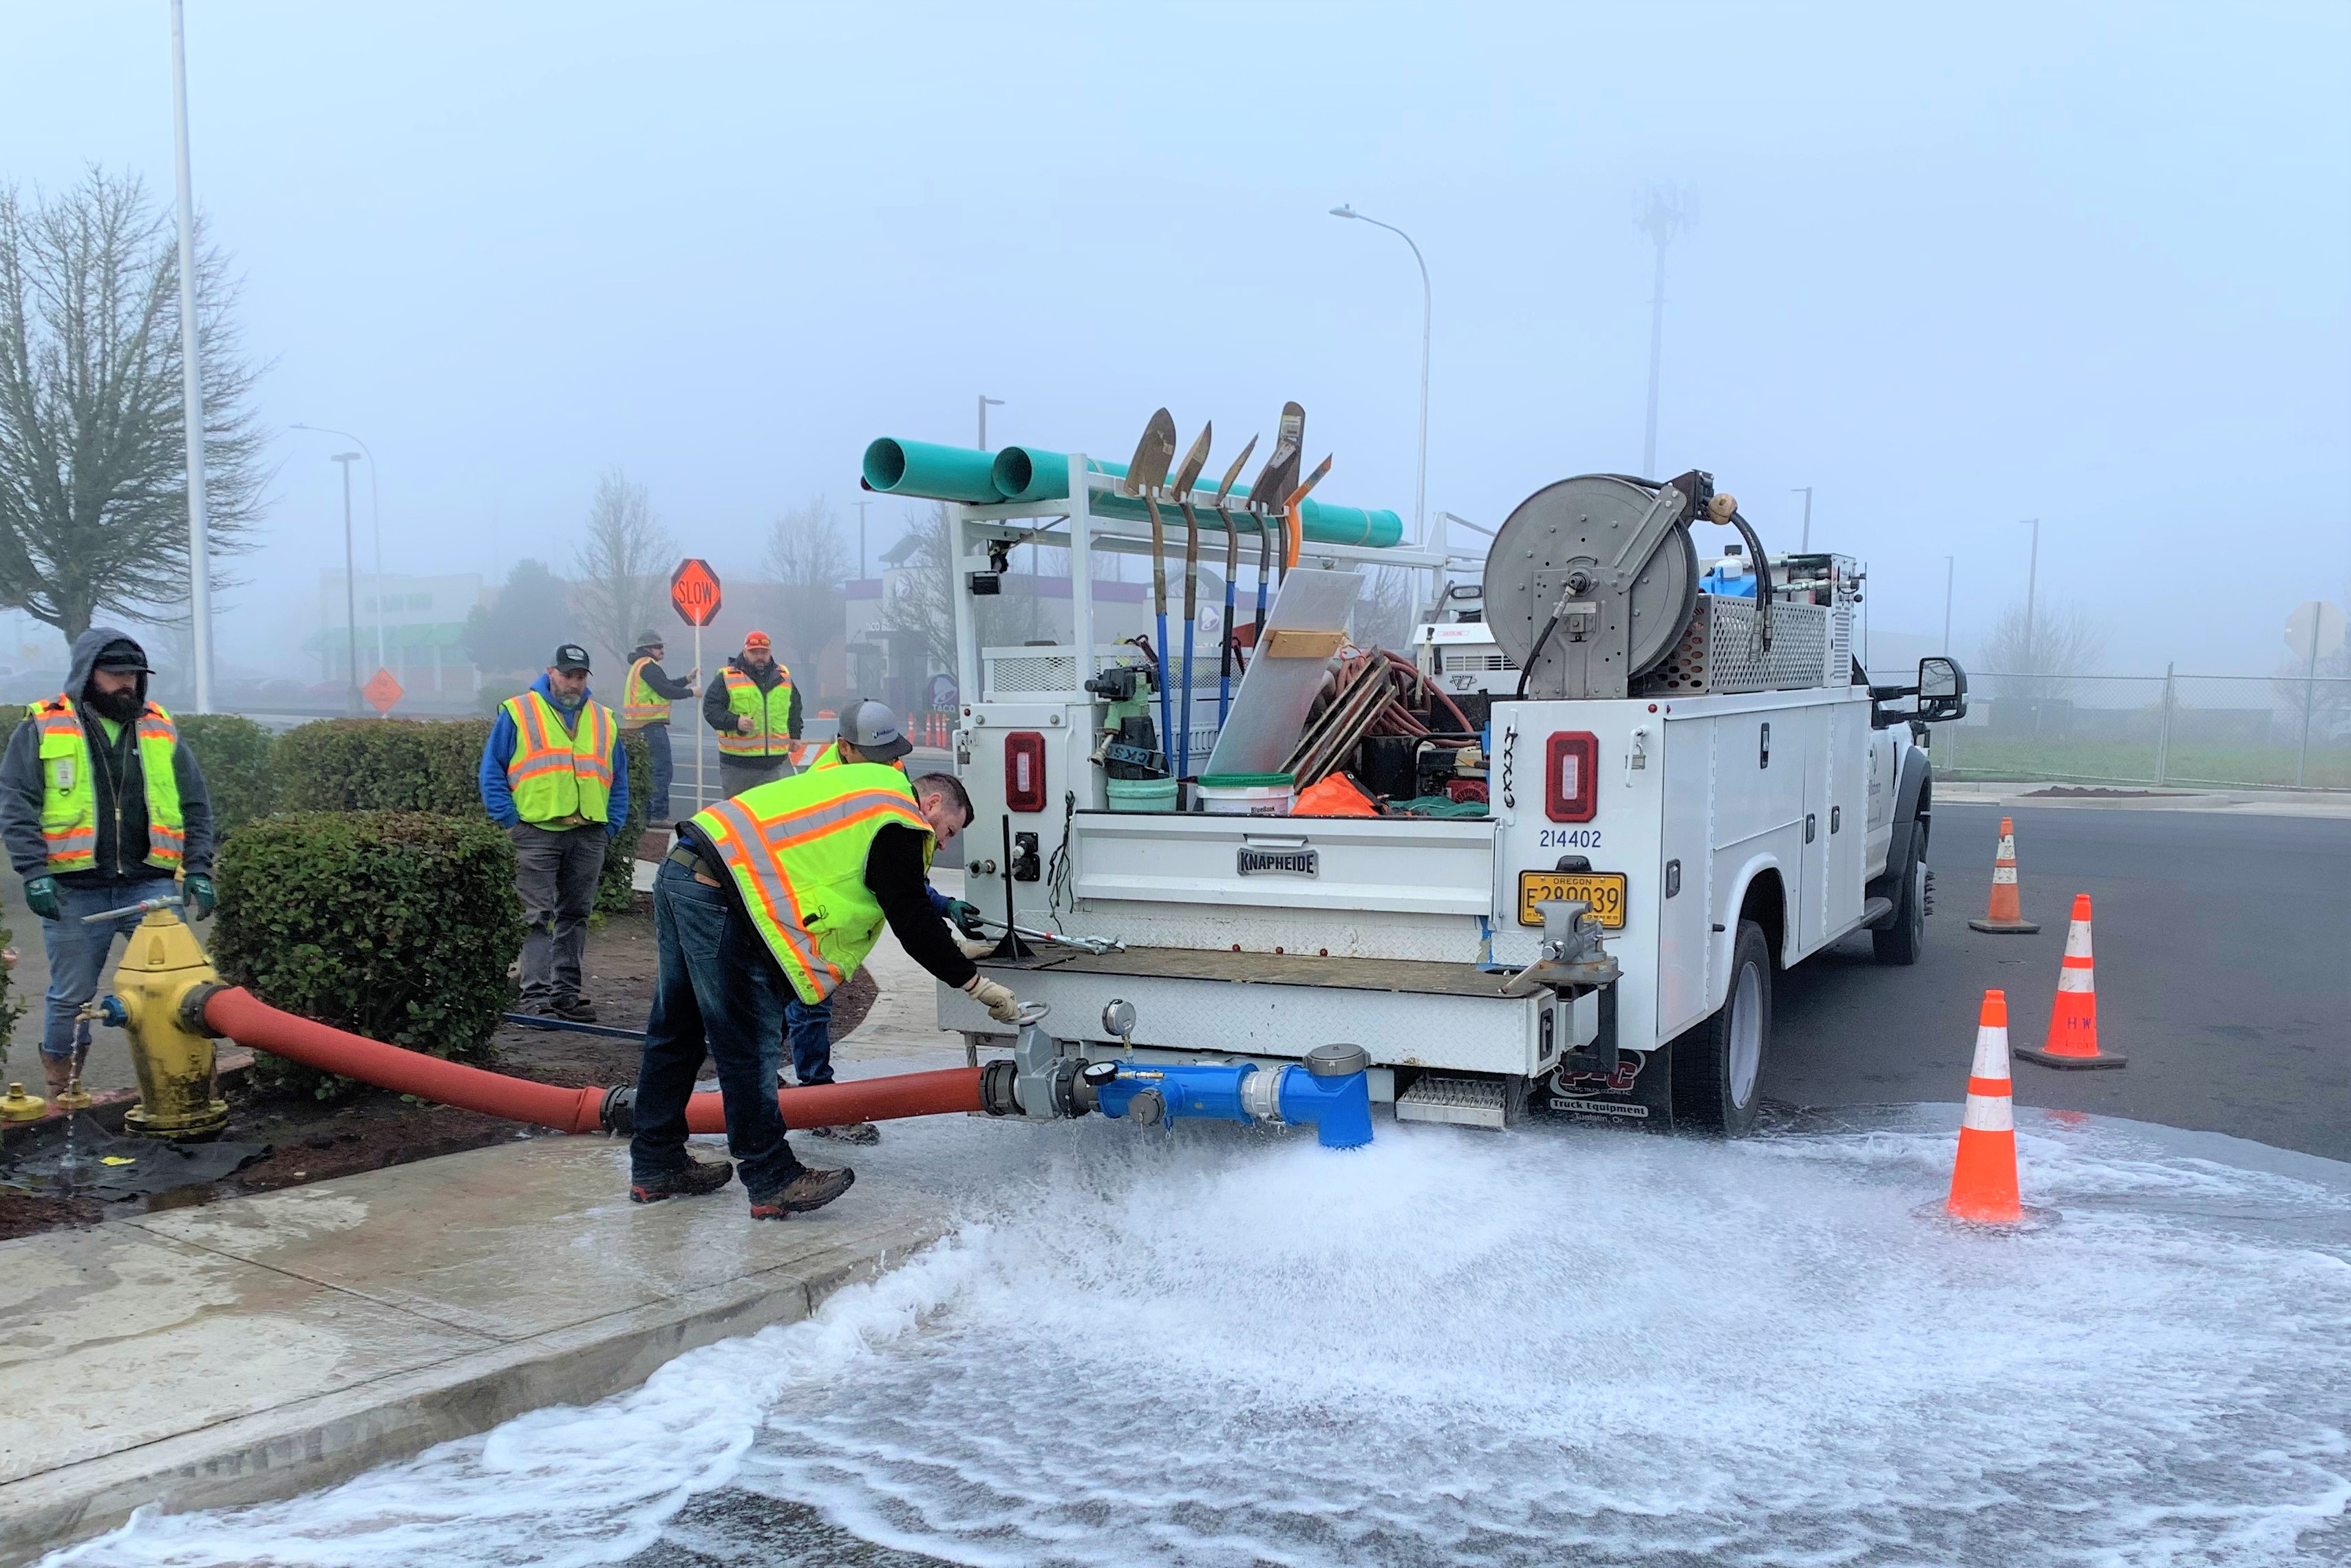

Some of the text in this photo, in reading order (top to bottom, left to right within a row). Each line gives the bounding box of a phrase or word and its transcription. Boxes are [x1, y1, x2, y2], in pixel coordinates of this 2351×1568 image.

[678, 581, 712, 605] SLOW
[932, 704, 956, 713] TACO
[1540, 830, 1602, 848] 214402
[1240, 852, 1314, 874] KNAPHEIDE
[1553, 1099, 1645, 1115] Truck Equipment
